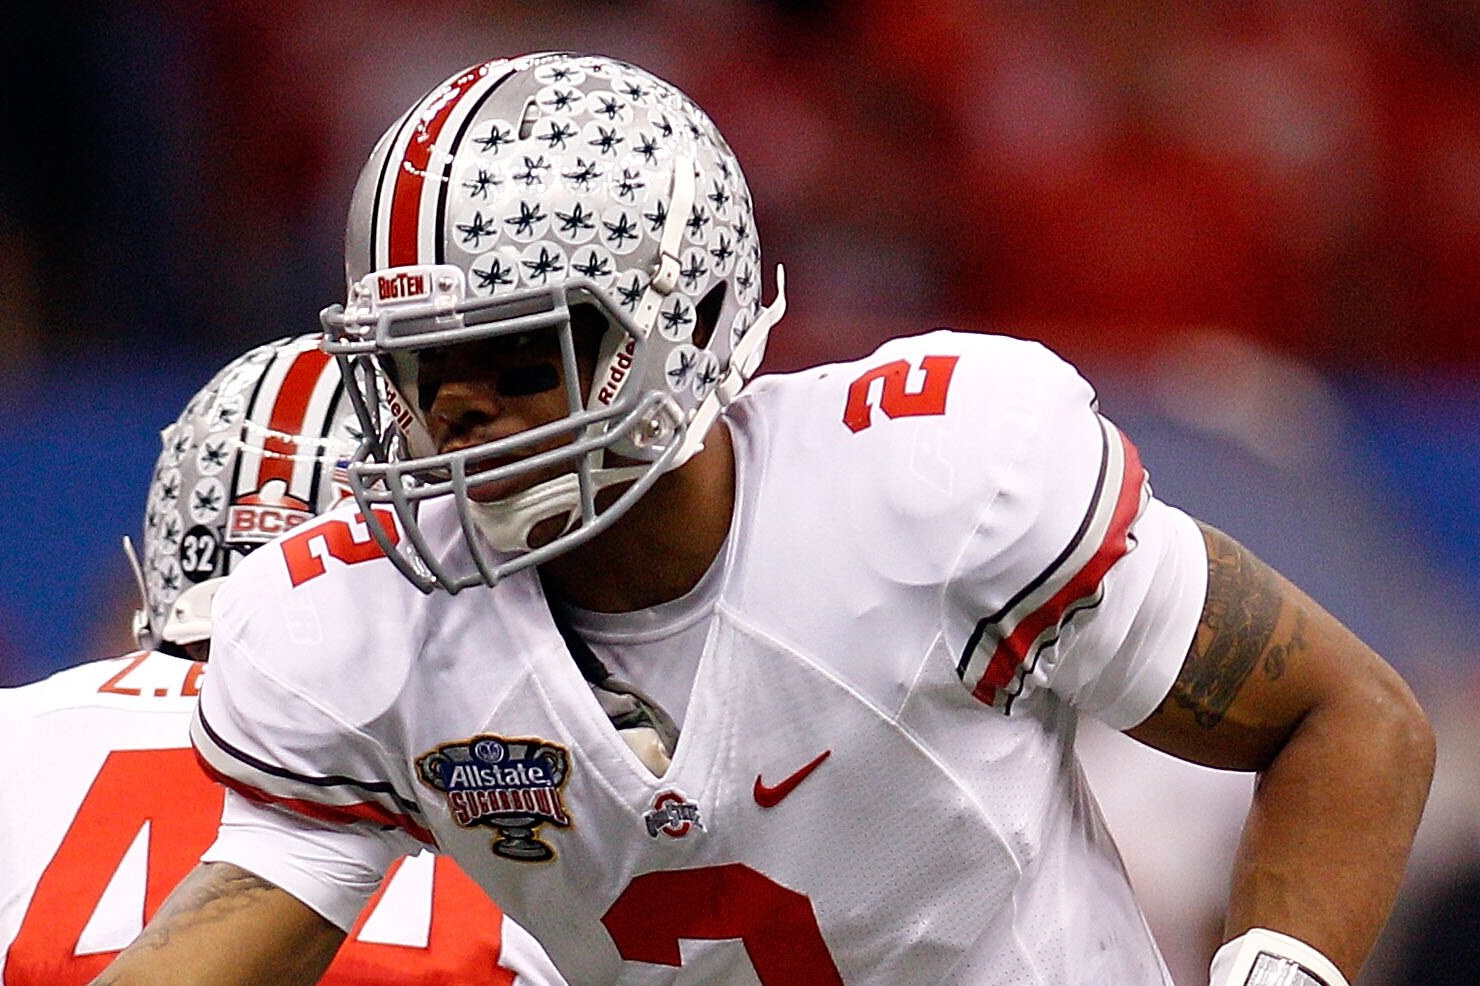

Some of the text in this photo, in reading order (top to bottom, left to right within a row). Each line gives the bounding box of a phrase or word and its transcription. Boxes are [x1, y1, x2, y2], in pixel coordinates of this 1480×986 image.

[842, 355, 960, 434] 2
[233, 509, 308, 533] BCS
[182, 534, 216, 572] 32
[280, 509, 400, 588] 2
[449, 764, 544, 788] Allstate
